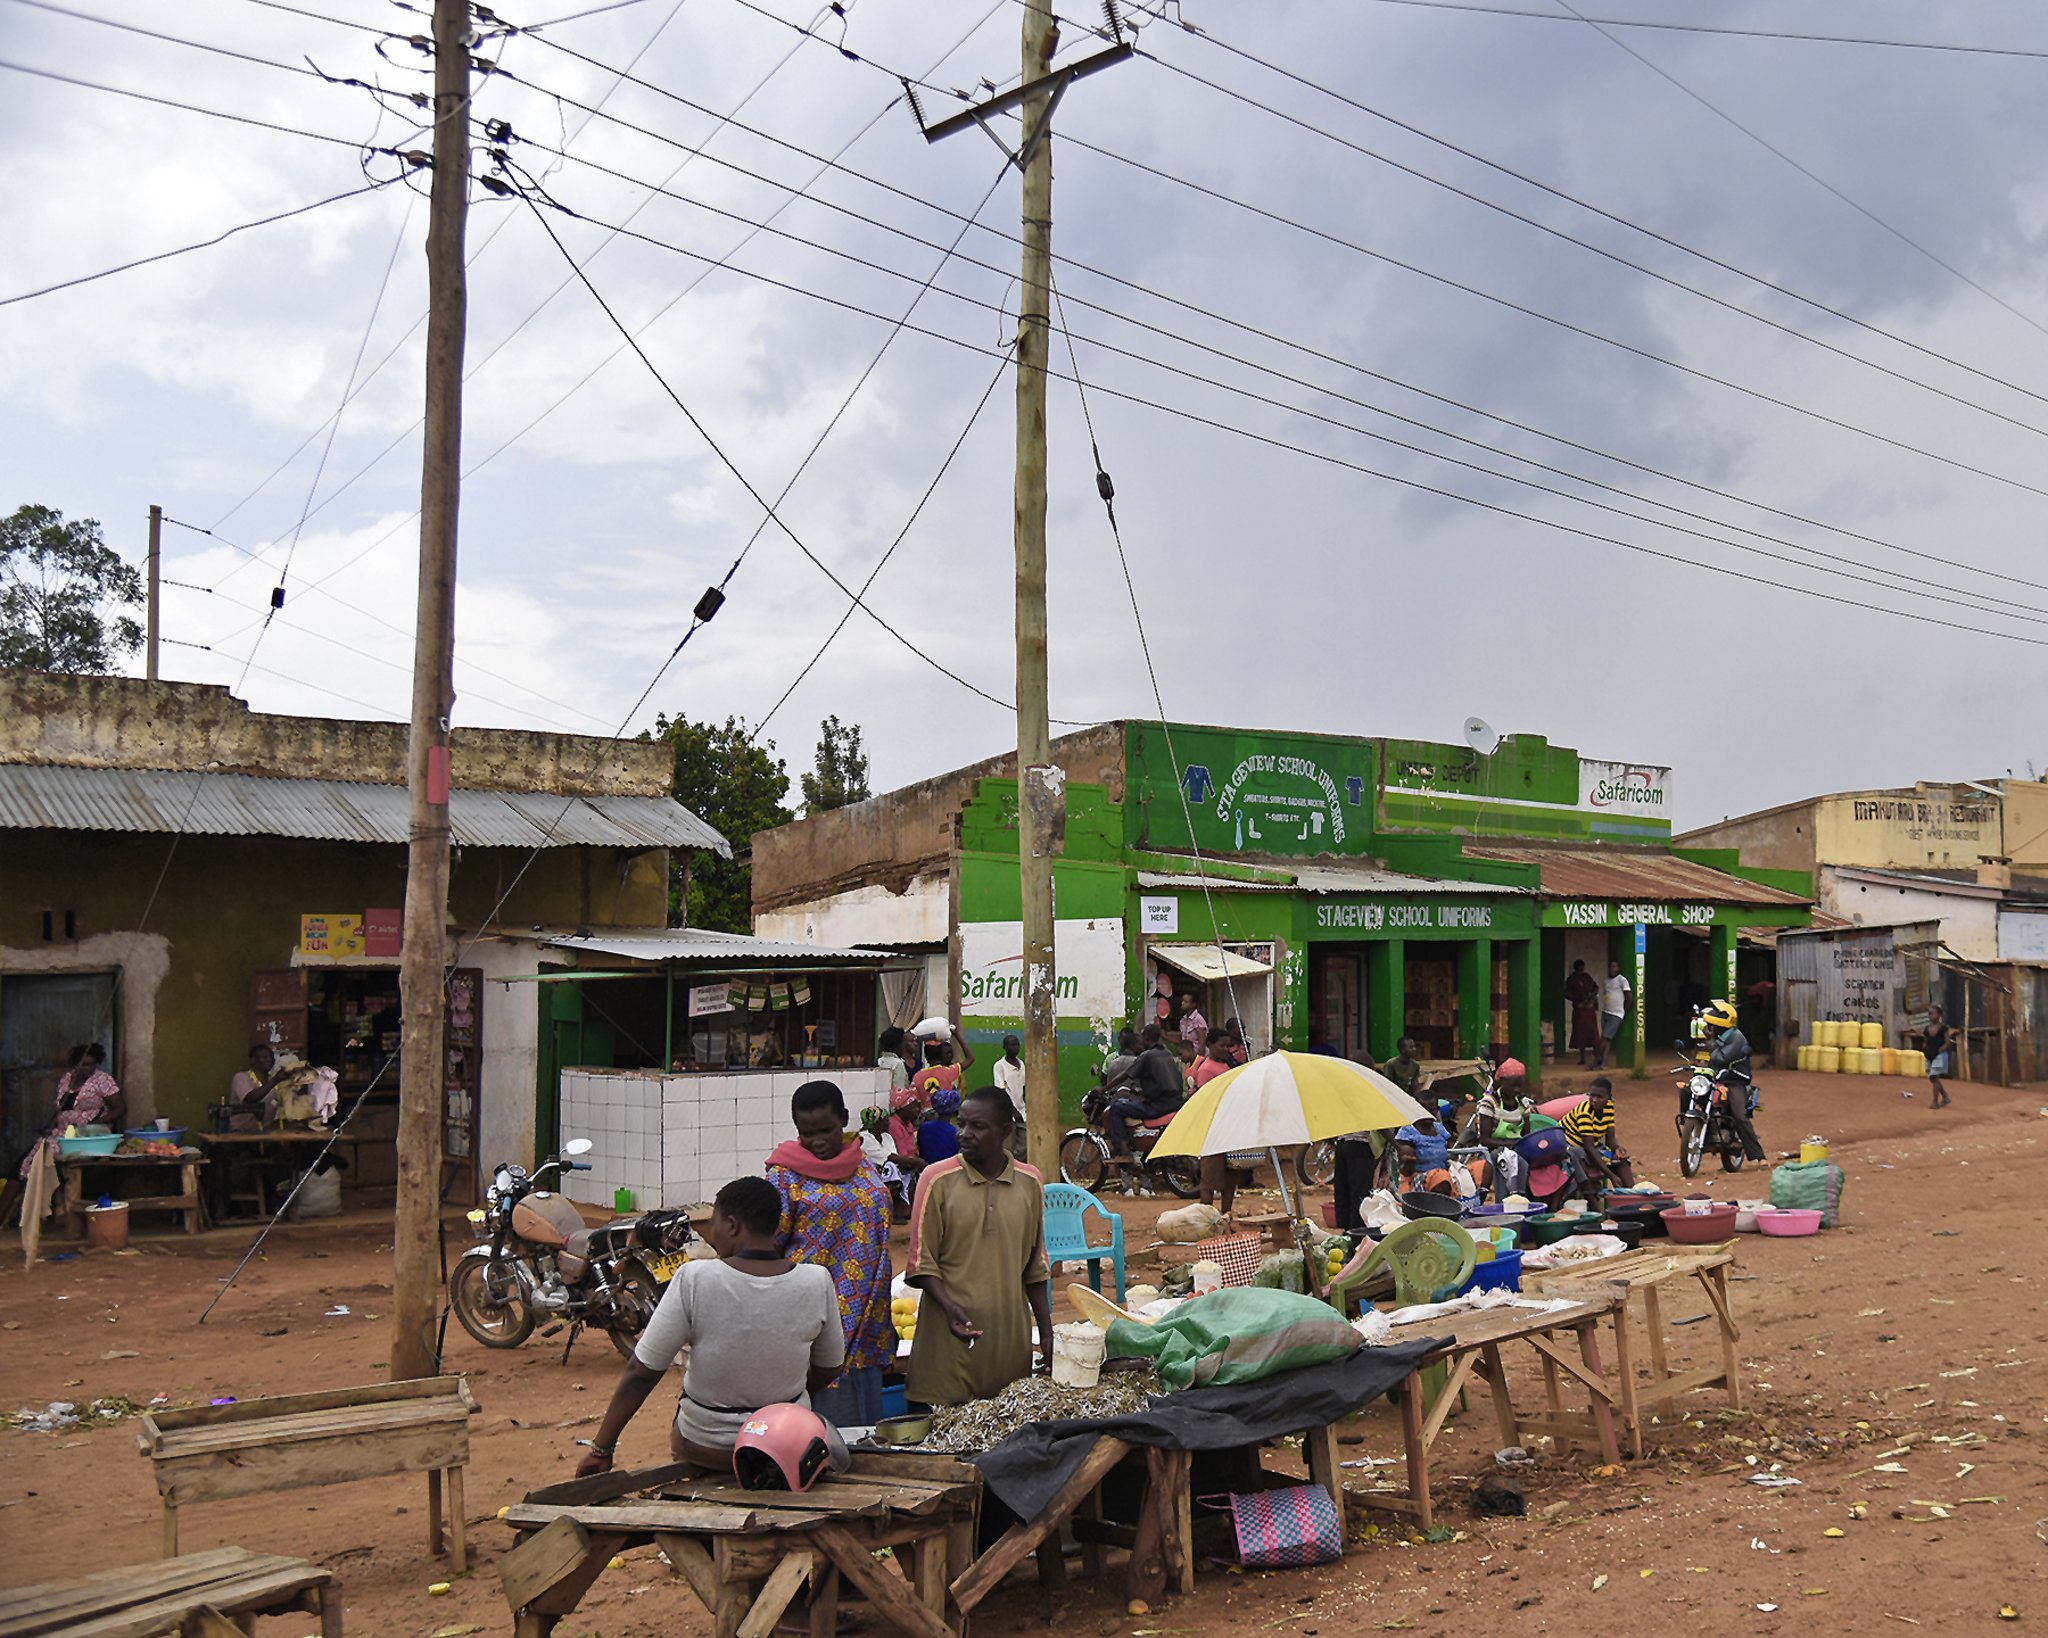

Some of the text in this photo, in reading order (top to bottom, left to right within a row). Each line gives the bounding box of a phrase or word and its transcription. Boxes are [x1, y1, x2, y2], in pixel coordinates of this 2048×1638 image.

[1278, 756, 1318, 782] SCHOOL
[1317, 769, 1346, 844] UNIFORMS
[1597, 779, 1663, 805] Safaricom
[1147, 904, 1172, 913] TOP UP
[1150, 913, 1169, 922] HERE
[1317, 904, 1492, 928] STAGEVIEW SCHOOL UNIFORMS
[1562, 903, 1715, 924] YASSIN GENERAL SHOP
[960, 967, 1079, 1000] Safarim
[1843, 978, 1885, 991] SCRATCH
[1843, 996, 1880, 1010] CARDS
